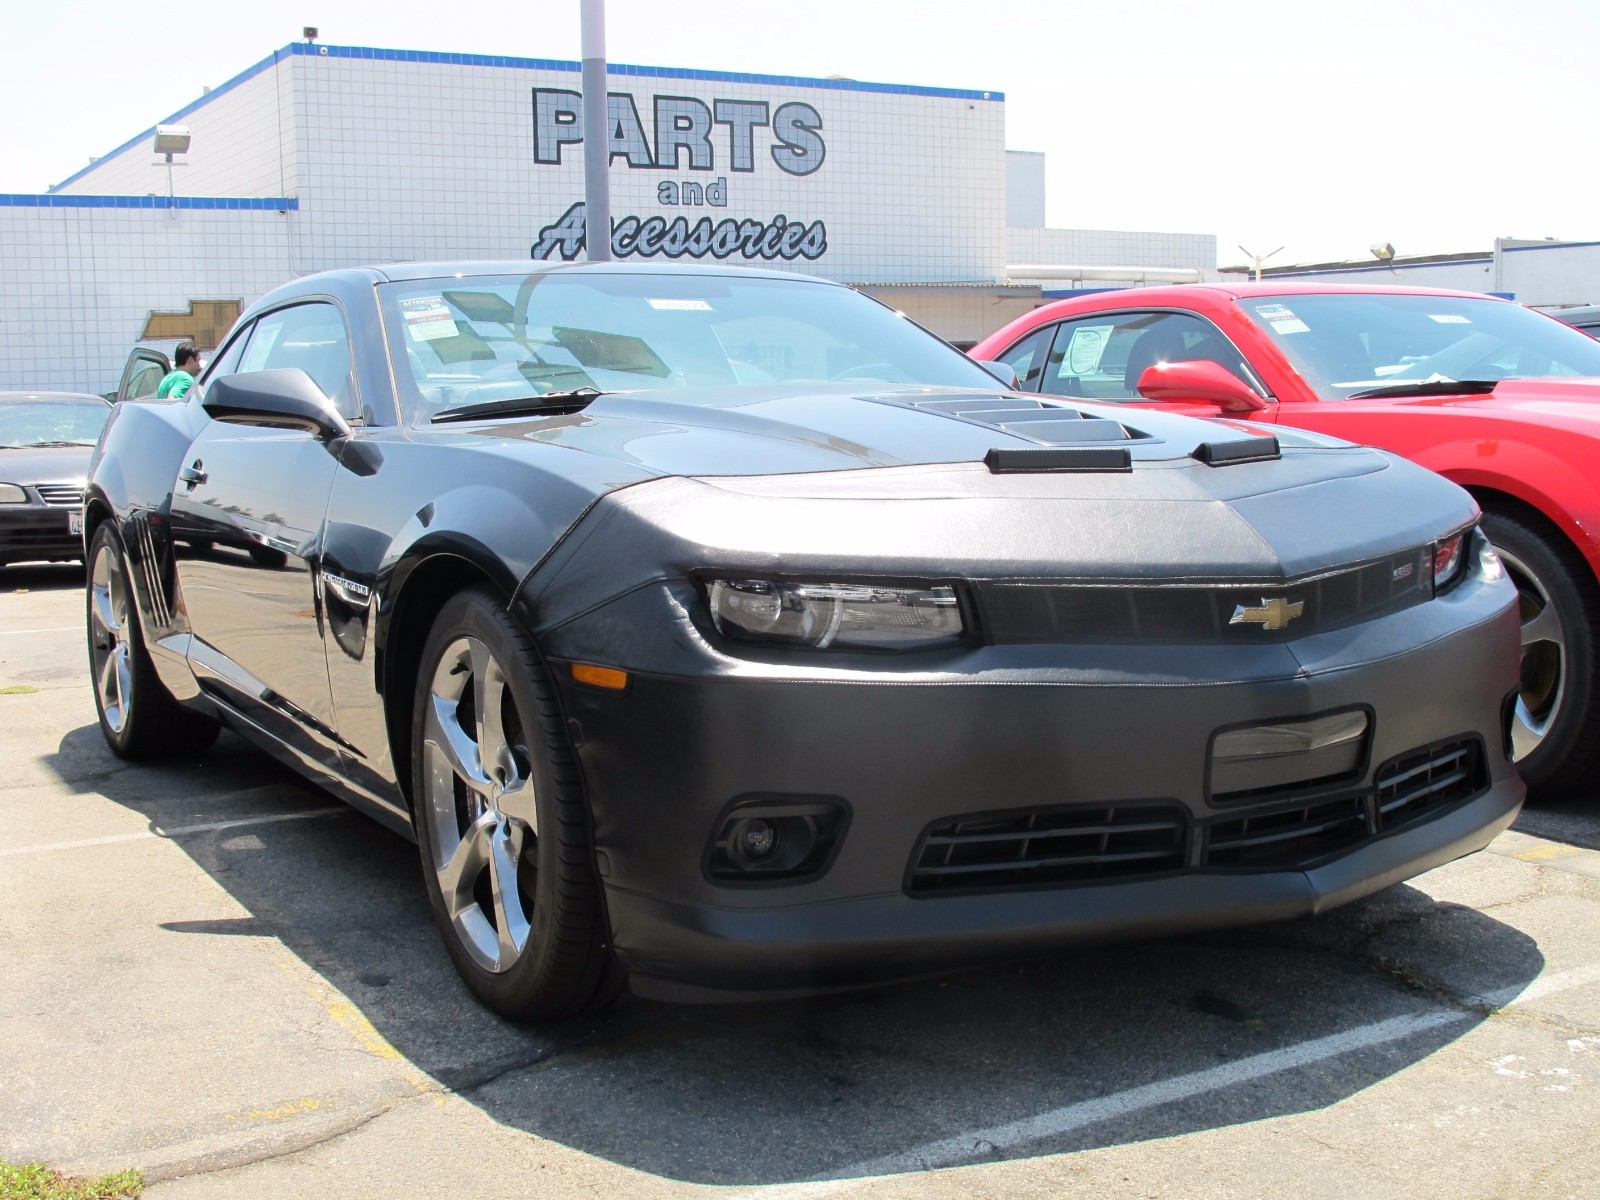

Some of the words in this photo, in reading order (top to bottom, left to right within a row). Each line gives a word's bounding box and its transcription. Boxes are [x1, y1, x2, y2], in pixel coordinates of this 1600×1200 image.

[532, 87, 826, 176] PARTS
[657, 177, 727, 207] and
[531, 201, 828, 260] Acessories
